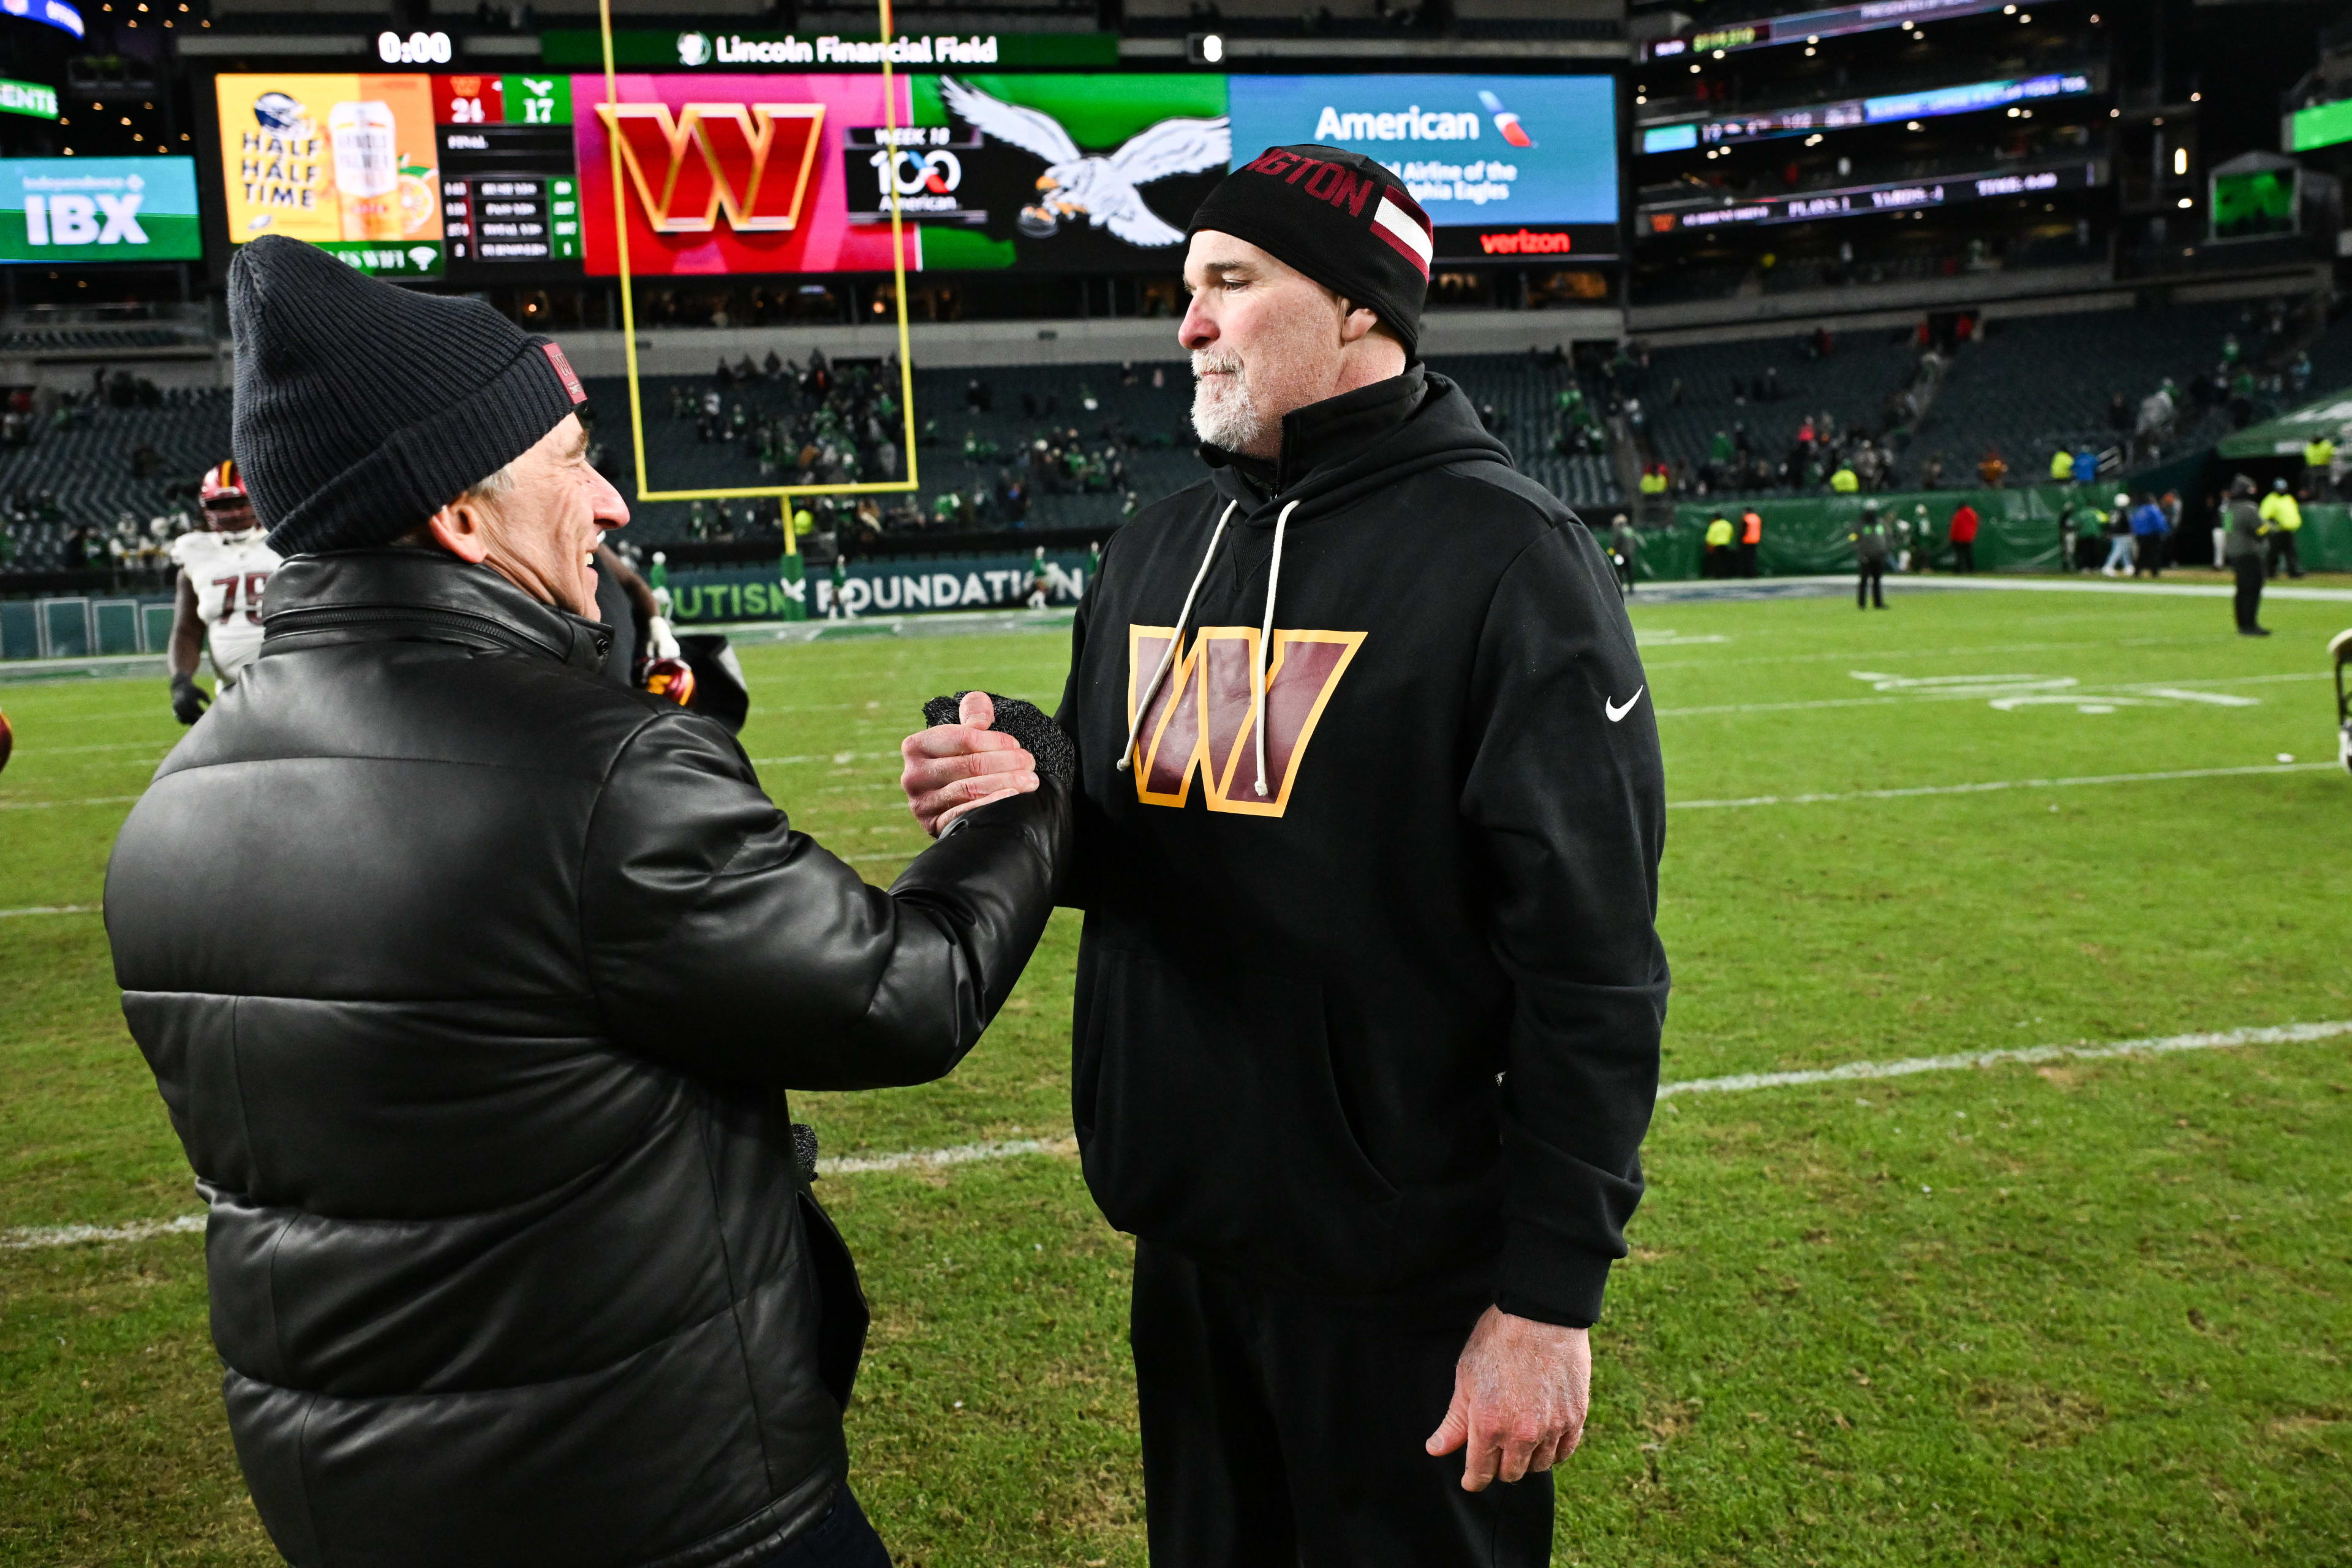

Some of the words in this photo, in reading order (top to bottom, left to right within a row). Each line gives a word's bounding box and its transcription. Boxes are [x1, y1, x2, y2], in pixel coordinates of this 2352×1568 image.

[379, 32, 451, 63] 0:00
[716, 35, 813, 62] Lincoln
[816, 36, 933, 62] Financial
[935, 36, 998, 62] Field
[523, 98, 554, 123] 17
[1314, 105, 1480, 140] American
[242, 132, 322, 157] HALF
[875, 127, 926, 145] WEEK
[241, 158, 320, 183] HALF
[1403, 160, 1462, 182] Airline
[1463, 160, 1485, 182] of
[1487, 160, 1517, 182] the
[244, 183, 314, 208] TIME
[1455, 181, 1510, 205] Eagles
[24, 193, 150, 245] IBX
[1480, 228, 1571, 254] verizon
[674, 582, 787, 618] UTIS
[816, 567, 1084, 613] FOUNDATIN
